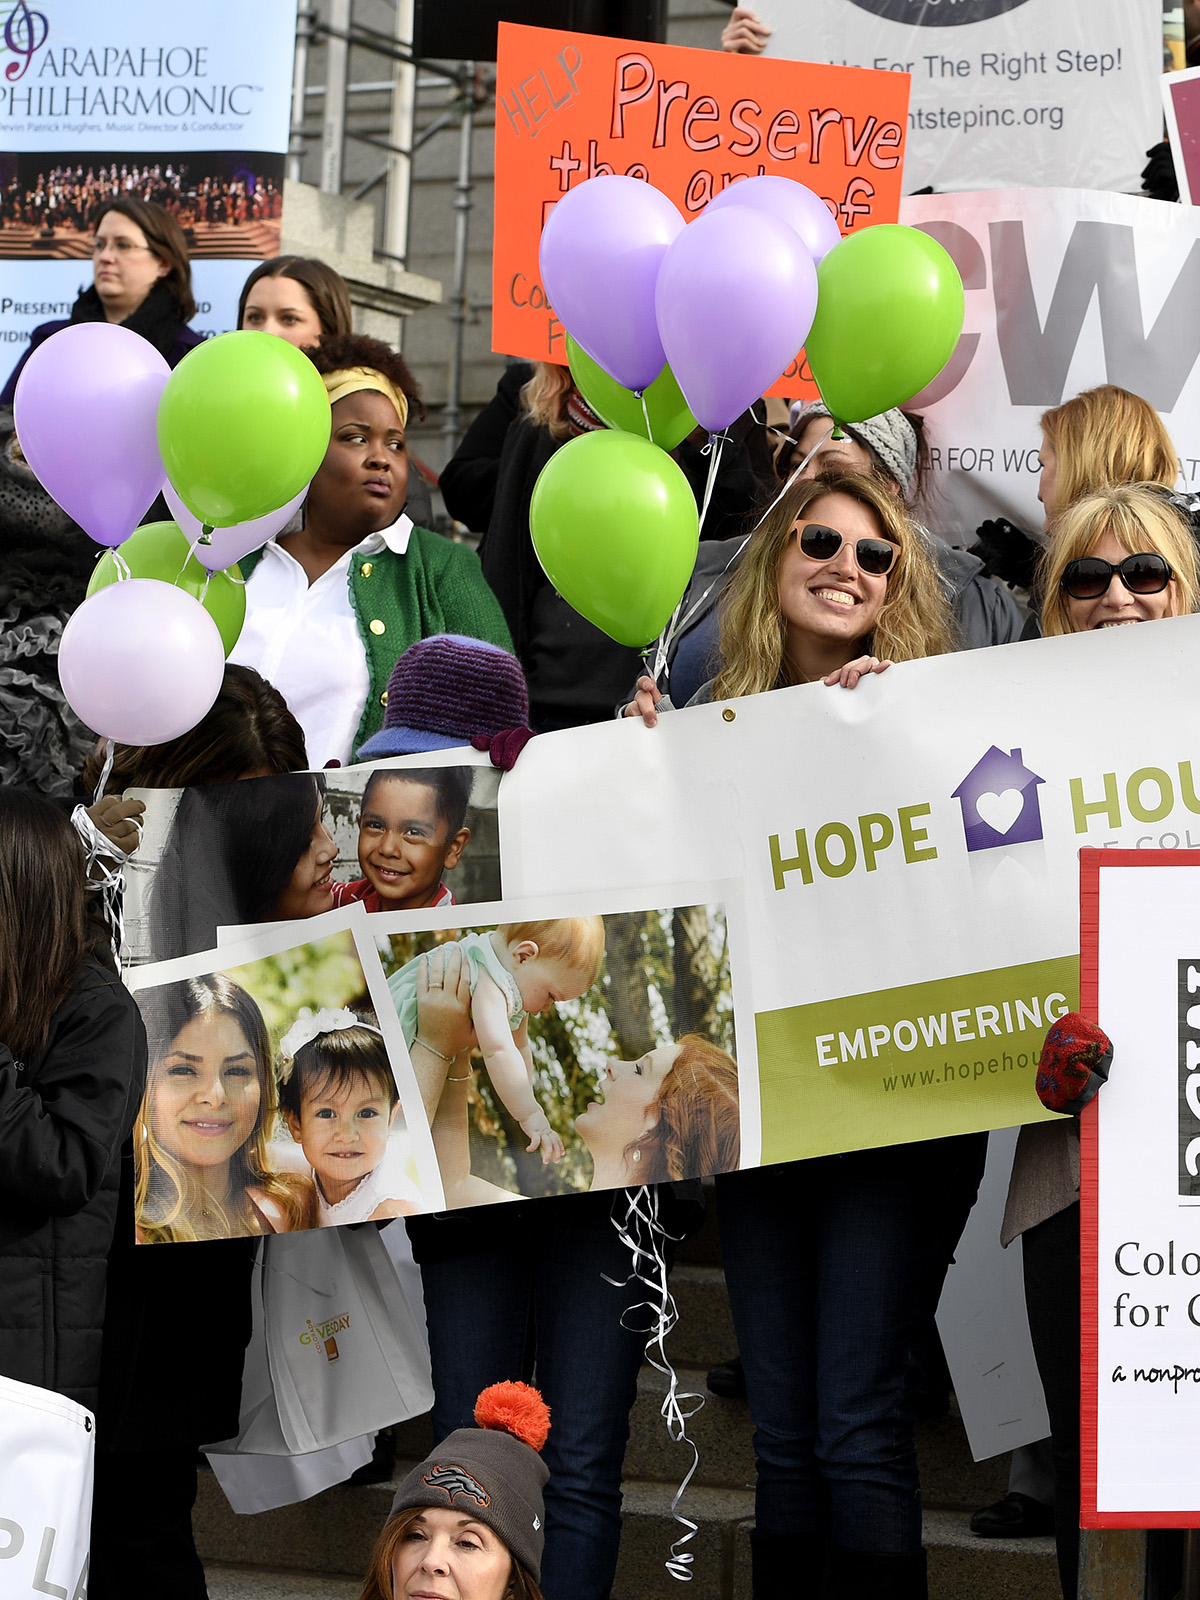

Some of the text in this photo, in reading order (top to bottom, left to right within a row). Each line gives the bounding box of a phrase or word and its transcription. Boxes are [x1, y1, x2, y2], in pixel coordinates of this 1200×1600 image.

[38, 46, 208, 78] ARAPAHOE
[923, 55, 971, 78] The
[980, 52, 1047, 80] Right
[1056, 47, 1123, 77] Step!
[500, 45, 582, 136] HELP
[27, 122, 59, 131] Patrick
[106, 122, 134, 131] Music
[139, 122, 179, 131] Director
[182, 122, 189, 131] &
[191, 122, 244, 131] Conductor
[609, 52, 902, 170] Preserve
[550, 141, 649, 191] the
[685, 165, 765, 212] ar
[948, 448, 994, 471] FOR
[768, 803, 938, 890] HOPE
[815, 992, 1070, 1067] EMPOWERING
[883, 1049, 1043, 1092] www.hopehou
[1113, 1293, 1169, 1328] for
[1112, 1365, 1126, 1383] a
